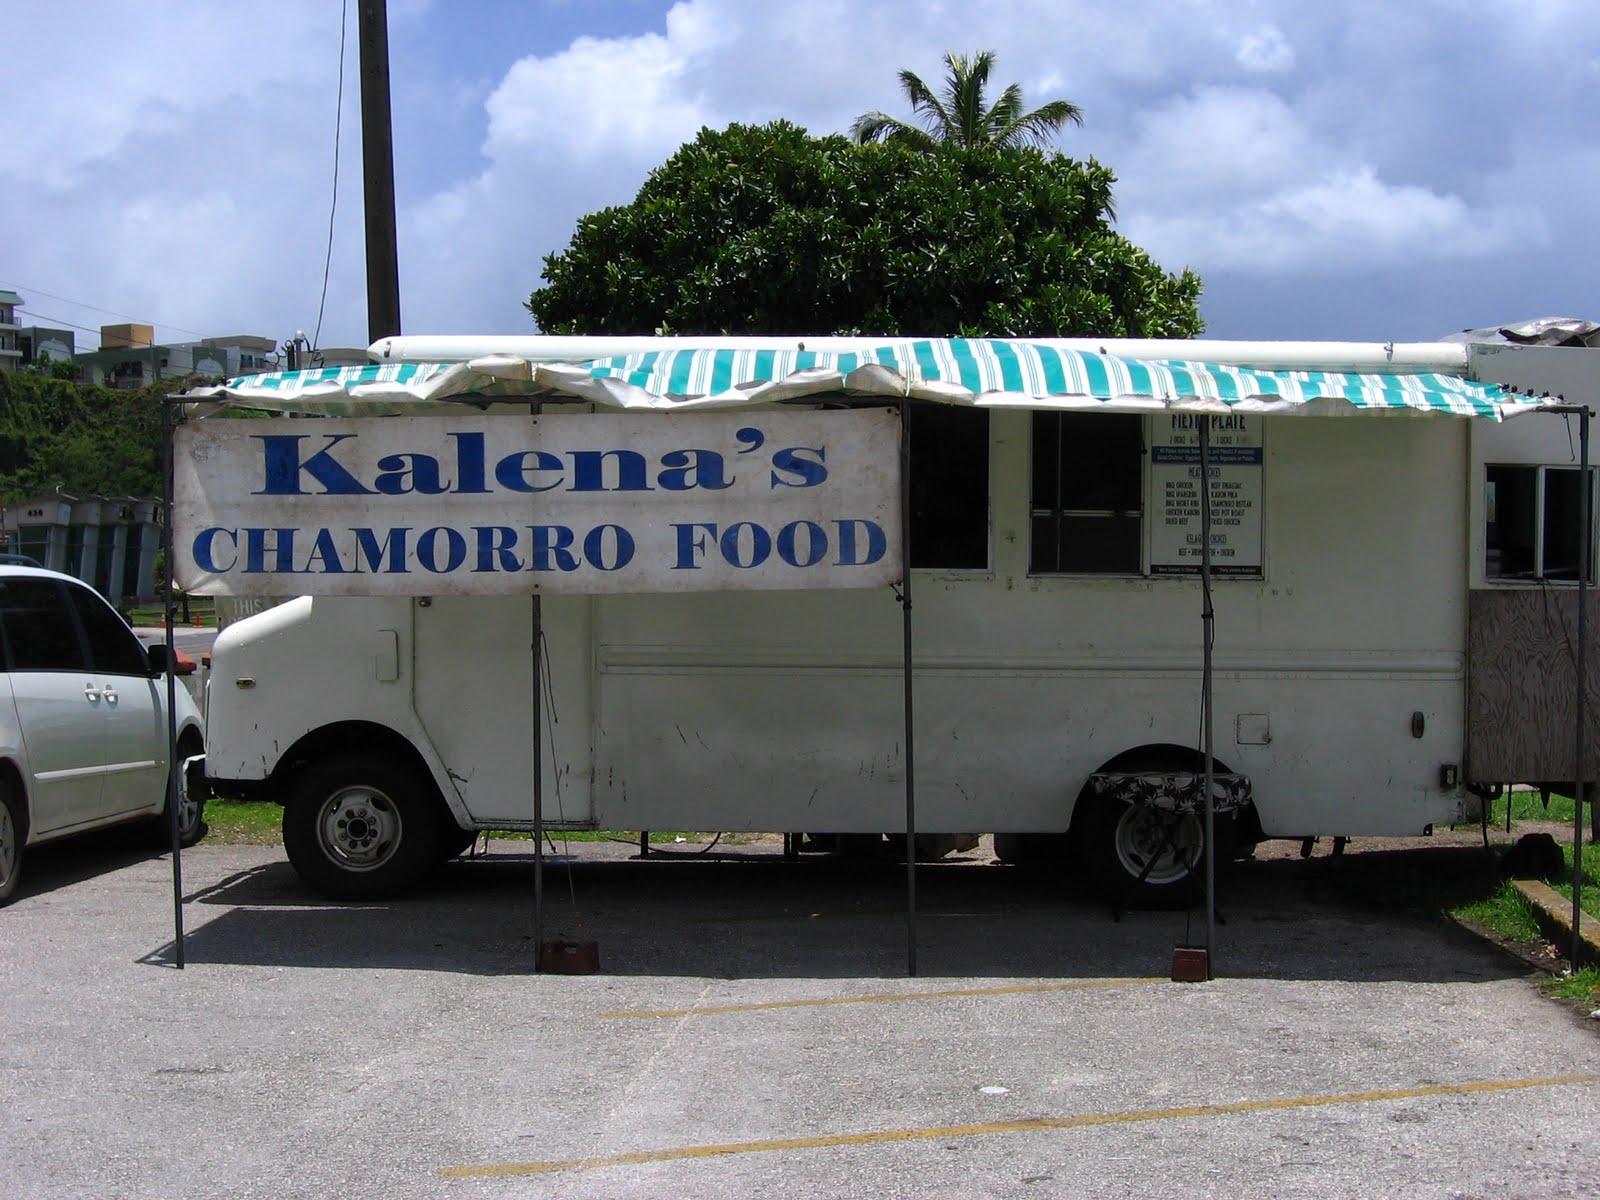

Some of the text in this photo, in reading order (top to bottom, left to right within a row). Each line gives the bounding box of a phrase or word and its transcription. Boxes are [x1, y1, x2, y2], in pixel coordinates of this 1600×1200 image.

[251, 426, 828, 496] Kalena's
[193, 519, 887, 573] CHAMORRO FOOD
[233, 600, 262, 615] THIS
